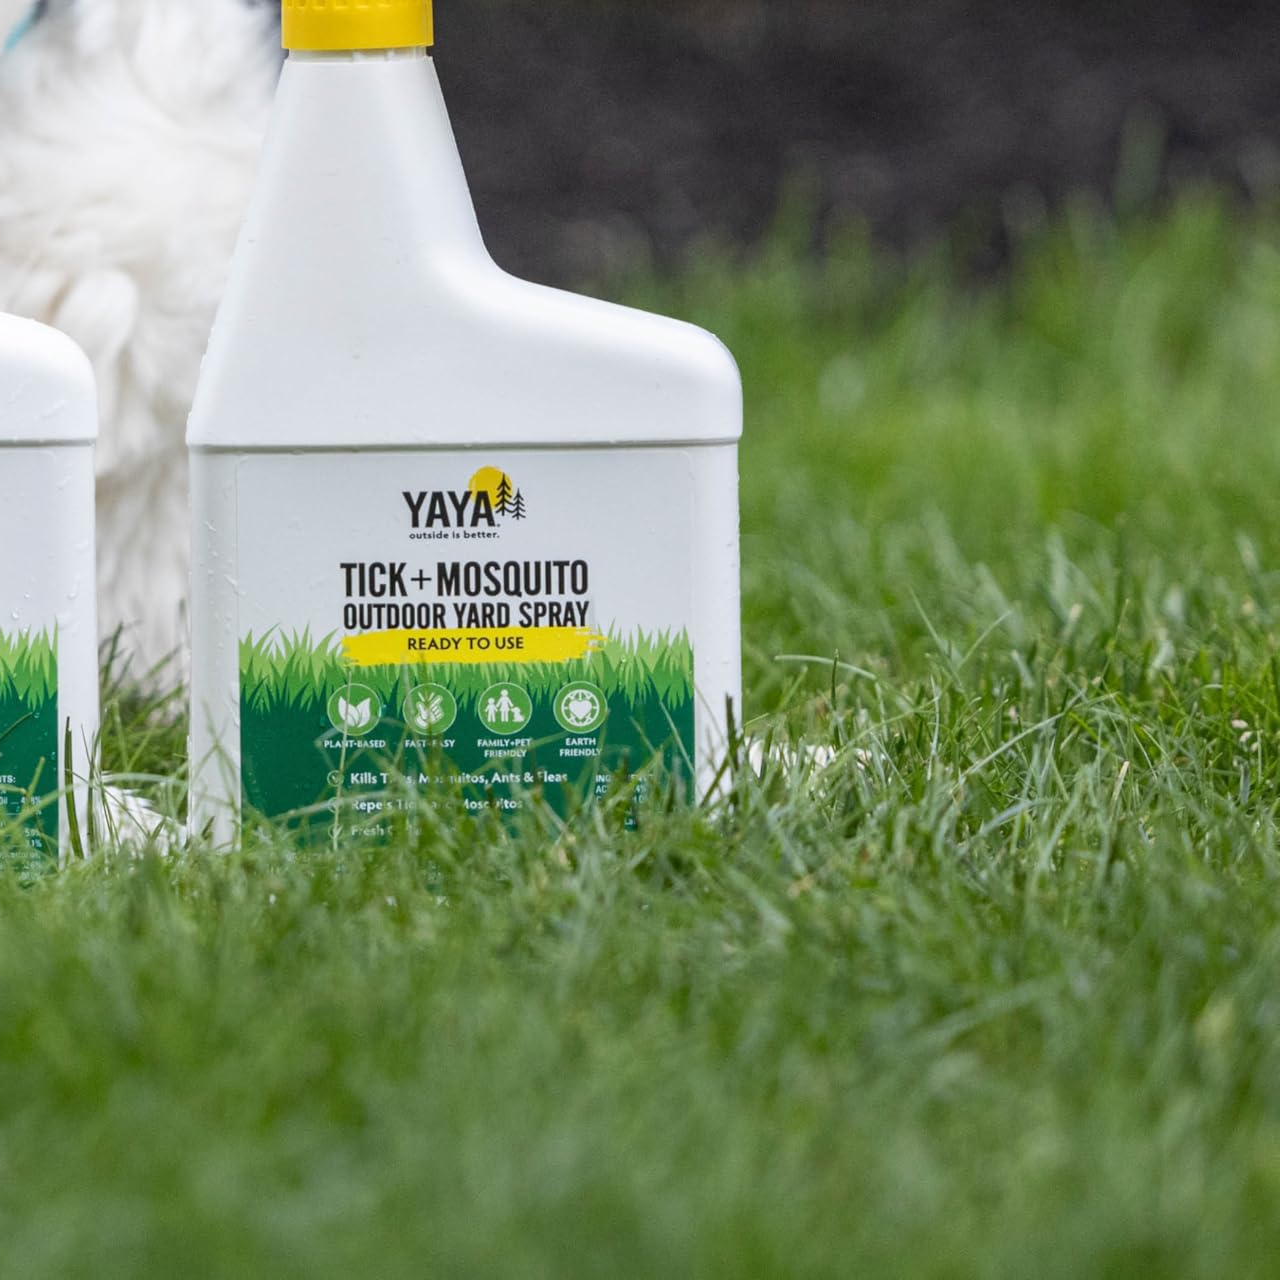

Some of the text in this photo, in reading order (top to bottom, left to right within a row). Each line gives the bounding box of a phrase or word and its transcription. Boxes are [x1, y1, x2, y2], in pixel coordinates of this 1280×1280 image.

[409, 530, 500, 540] outside is better.
[343, 601, 590, 630] OUTDOOR YARD SPRAY
[408, 636, 524, 651] READY TO USE
[565, 737, 596, 746] EARTH
[484, 749, 527, 758] FRIENDLY
[559, 747, 601, 757] FRIENDLY
[350, 772, 378, 784] Kills
[491, 771, 522, 784] Ants
[524, 771, 534, 783] &
